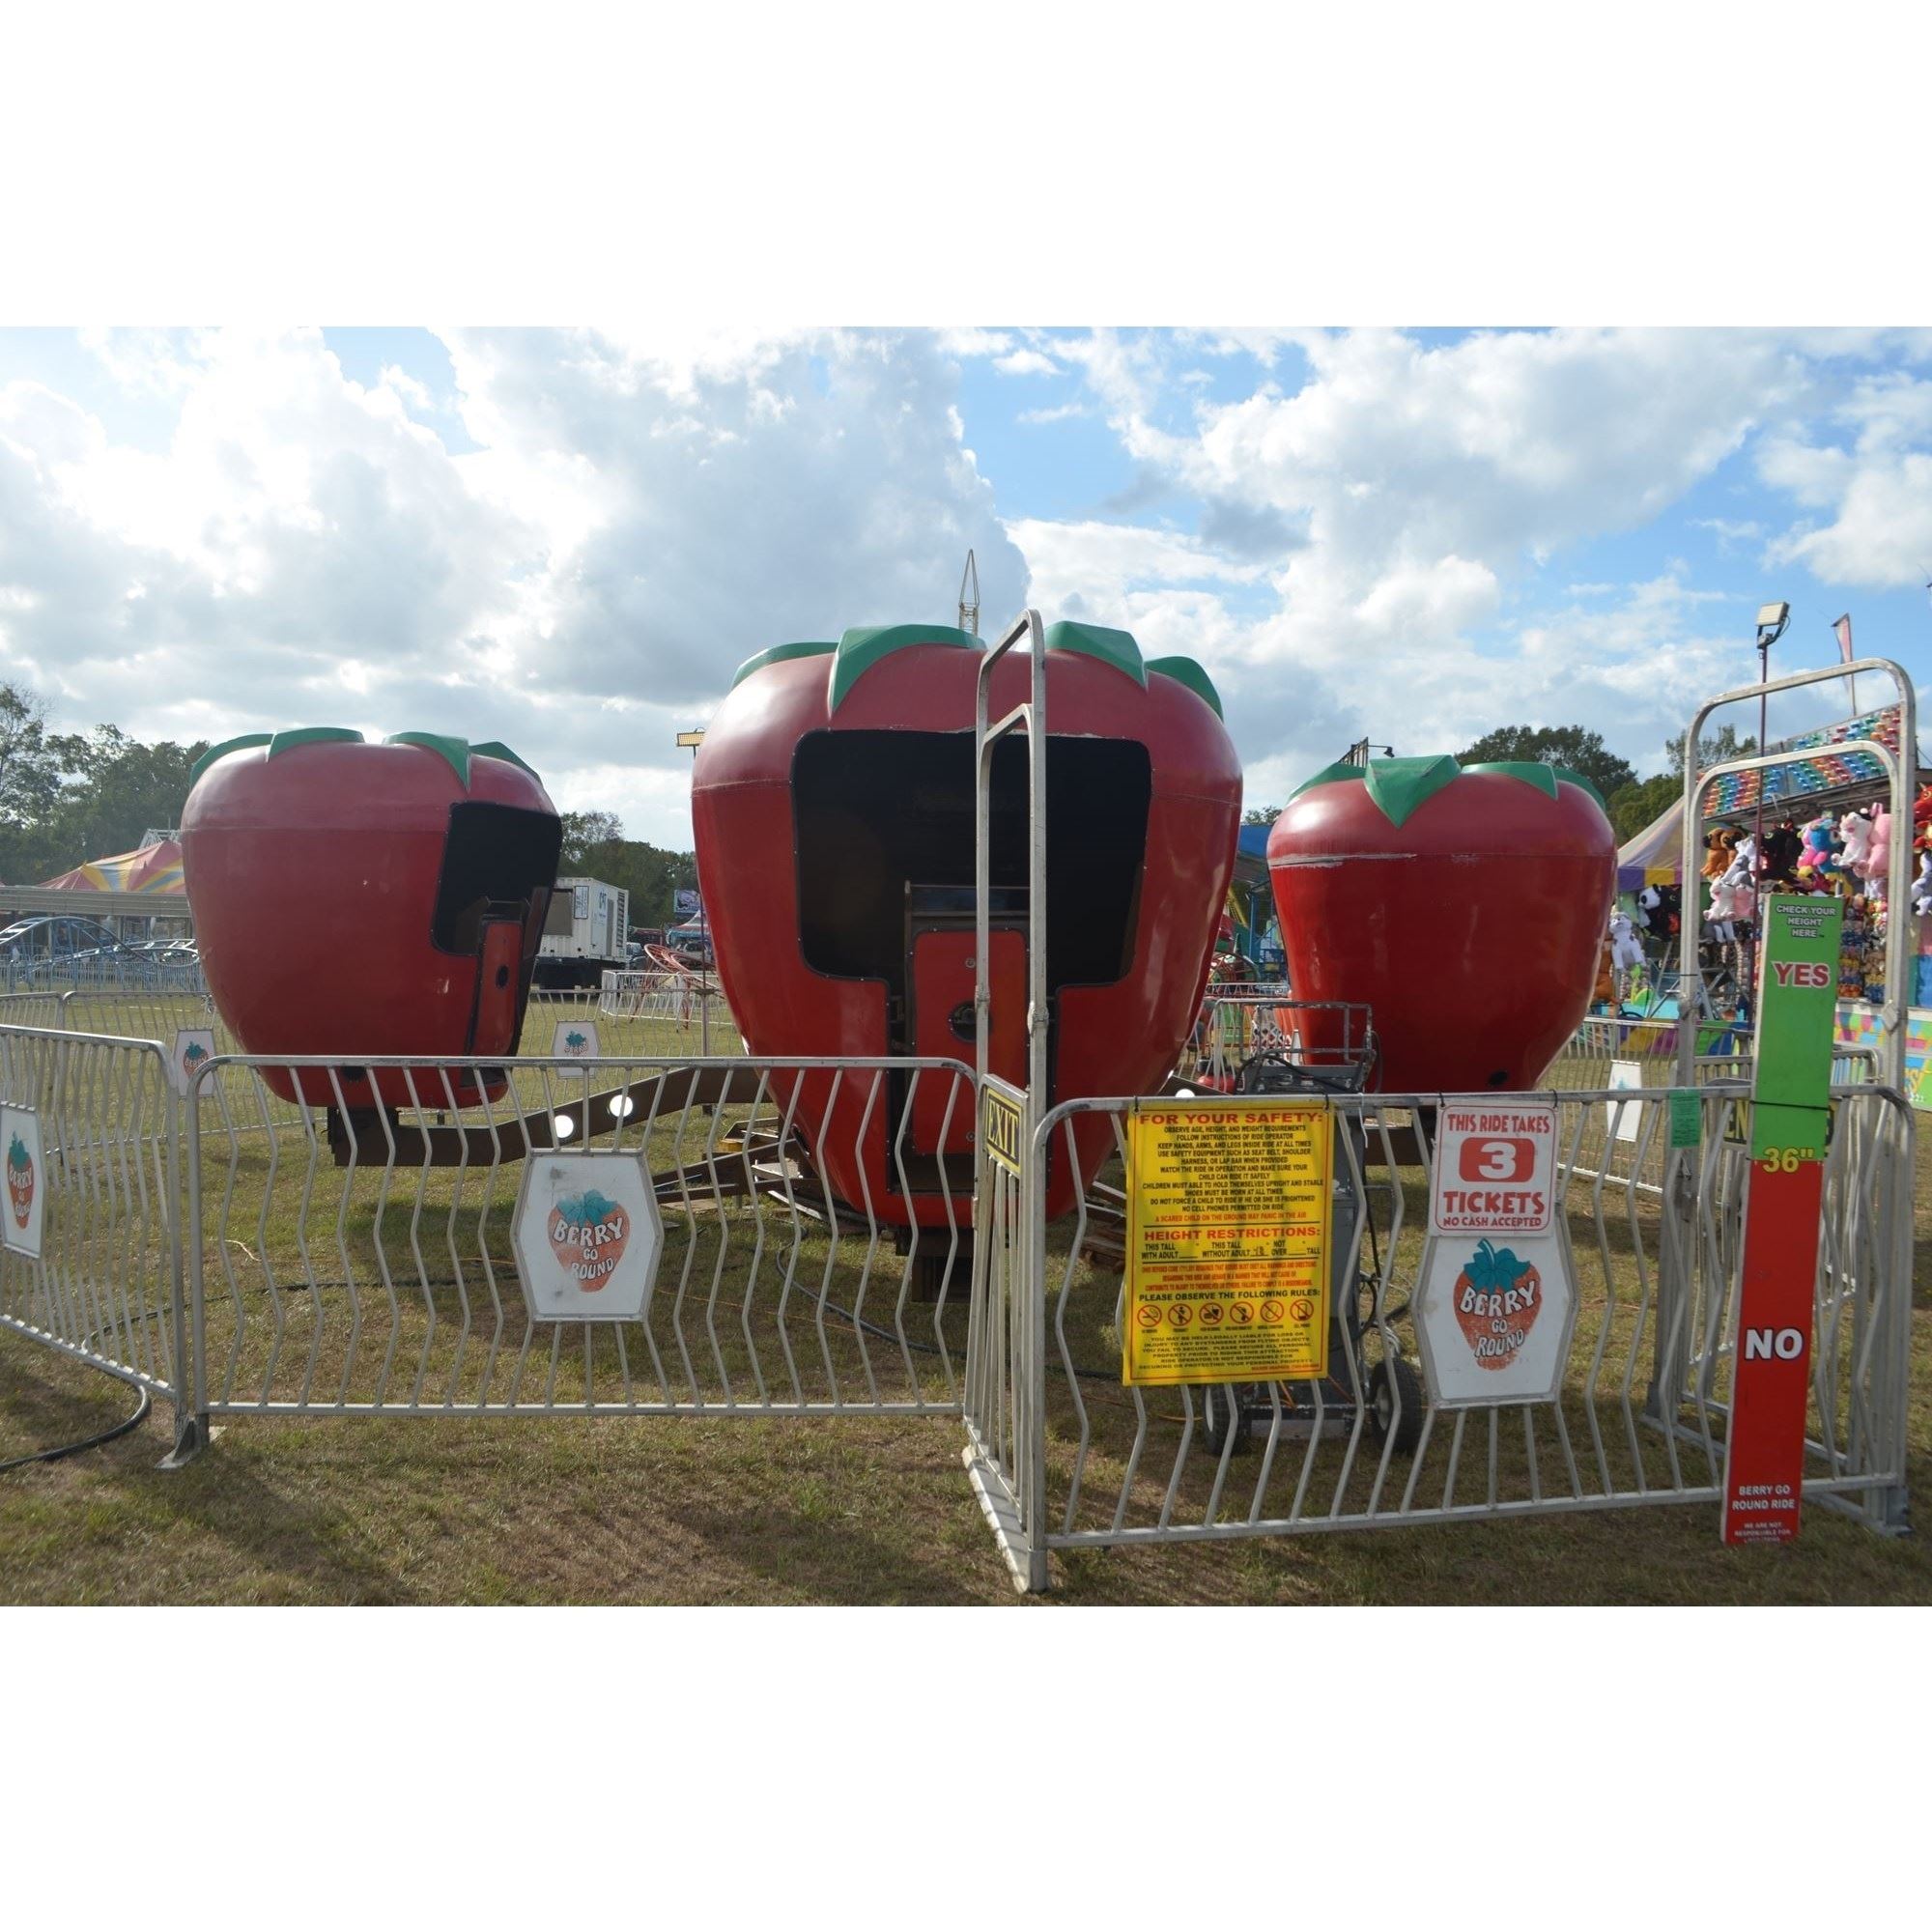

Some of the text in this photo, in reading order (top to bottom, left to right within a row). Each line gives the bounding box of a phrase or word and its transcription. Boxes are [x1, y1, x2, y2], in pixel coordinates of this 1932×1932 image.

[1776, 904, 1836, 916] CHECK YOUR
[1788, 917, 1823, 926] HEIGHT
[1792, 928, 1817, 938] HERE
[1773, 961, 1830, 988] YES
[1140, 1112, 1322, 1124] FOR YOUR SAFETY:
[1447, 1114, 1549, 1134] THIS RIDE TAKES
[988, 1098, 1019, 1160] EXIT
[1478, 1142, 1518, 1179] 3
[1762, 1147, 1814, 1174] 36"
[1443, 1191, 1546, 1215] TICKETS
[553, 1217, 624, 1247] BERRY
[1443, 1217, 1542, 1227] NO CASH ACCEPTED
[1144, 1227, 1321, 1240] HEIGHT RESTRICTIONS:
[582, 1248, 599, 1261] GO
[571, 1258, 615, 1280] ROUND
[1459, 1280, 1536, 1318] BERRY
[1491, 1318, 1508, 1334] GO
[1474, 1328, 1525, 1358] ROUND
[1745, 1328, 1804, 1360] NO
[1739, 1484, 1791, 1496] BERRY GO
[1732, 1498, 1796, 1511] ROUND RIDE
